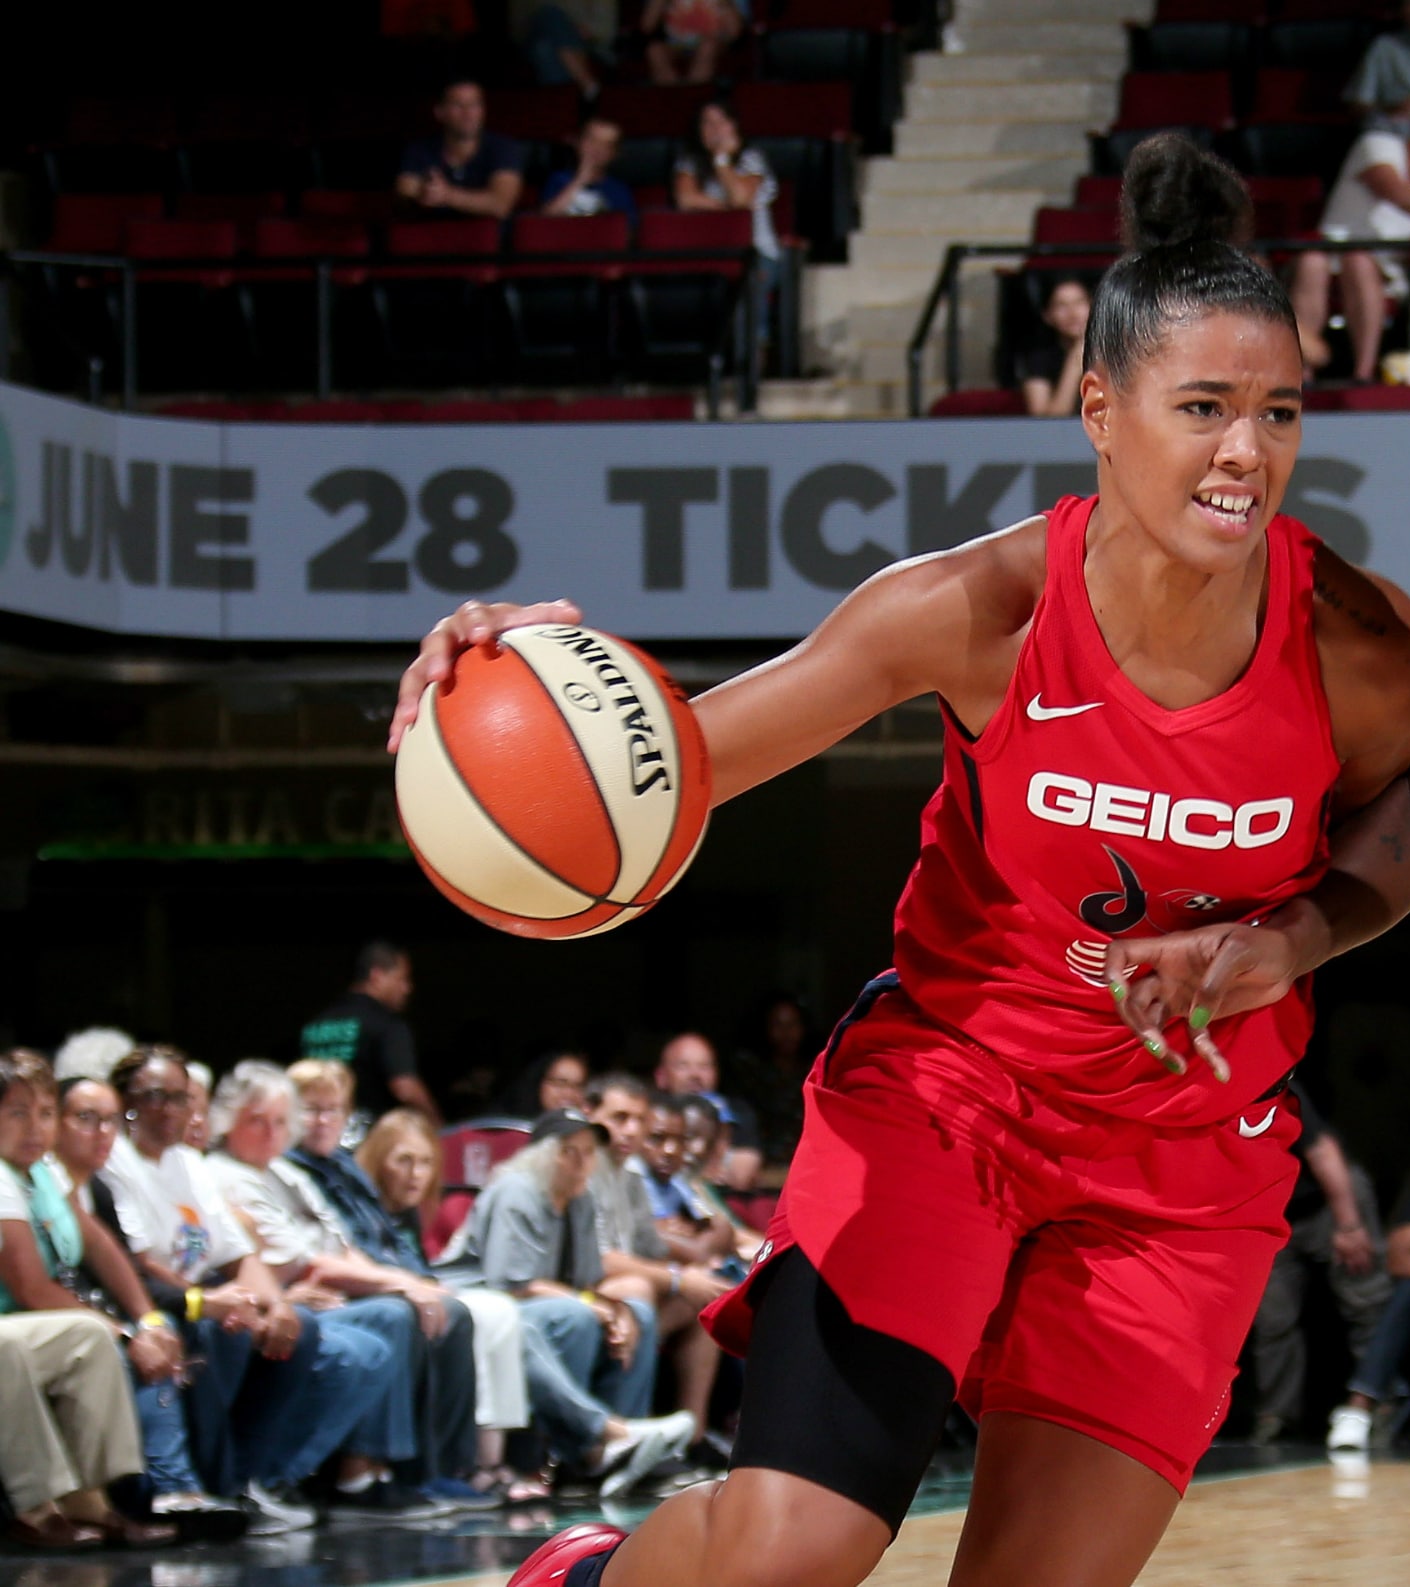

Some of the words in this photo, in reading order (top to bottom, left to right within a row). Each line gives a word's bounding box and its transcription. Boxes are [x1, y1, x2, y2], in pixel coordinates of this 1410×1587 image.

[25, 439, 257, 592] JUNE
[305, 467, 520, 594] 28
[535, 626, 672, 797] SPALDING
[1026, 770, 1294, 851] GEICO
